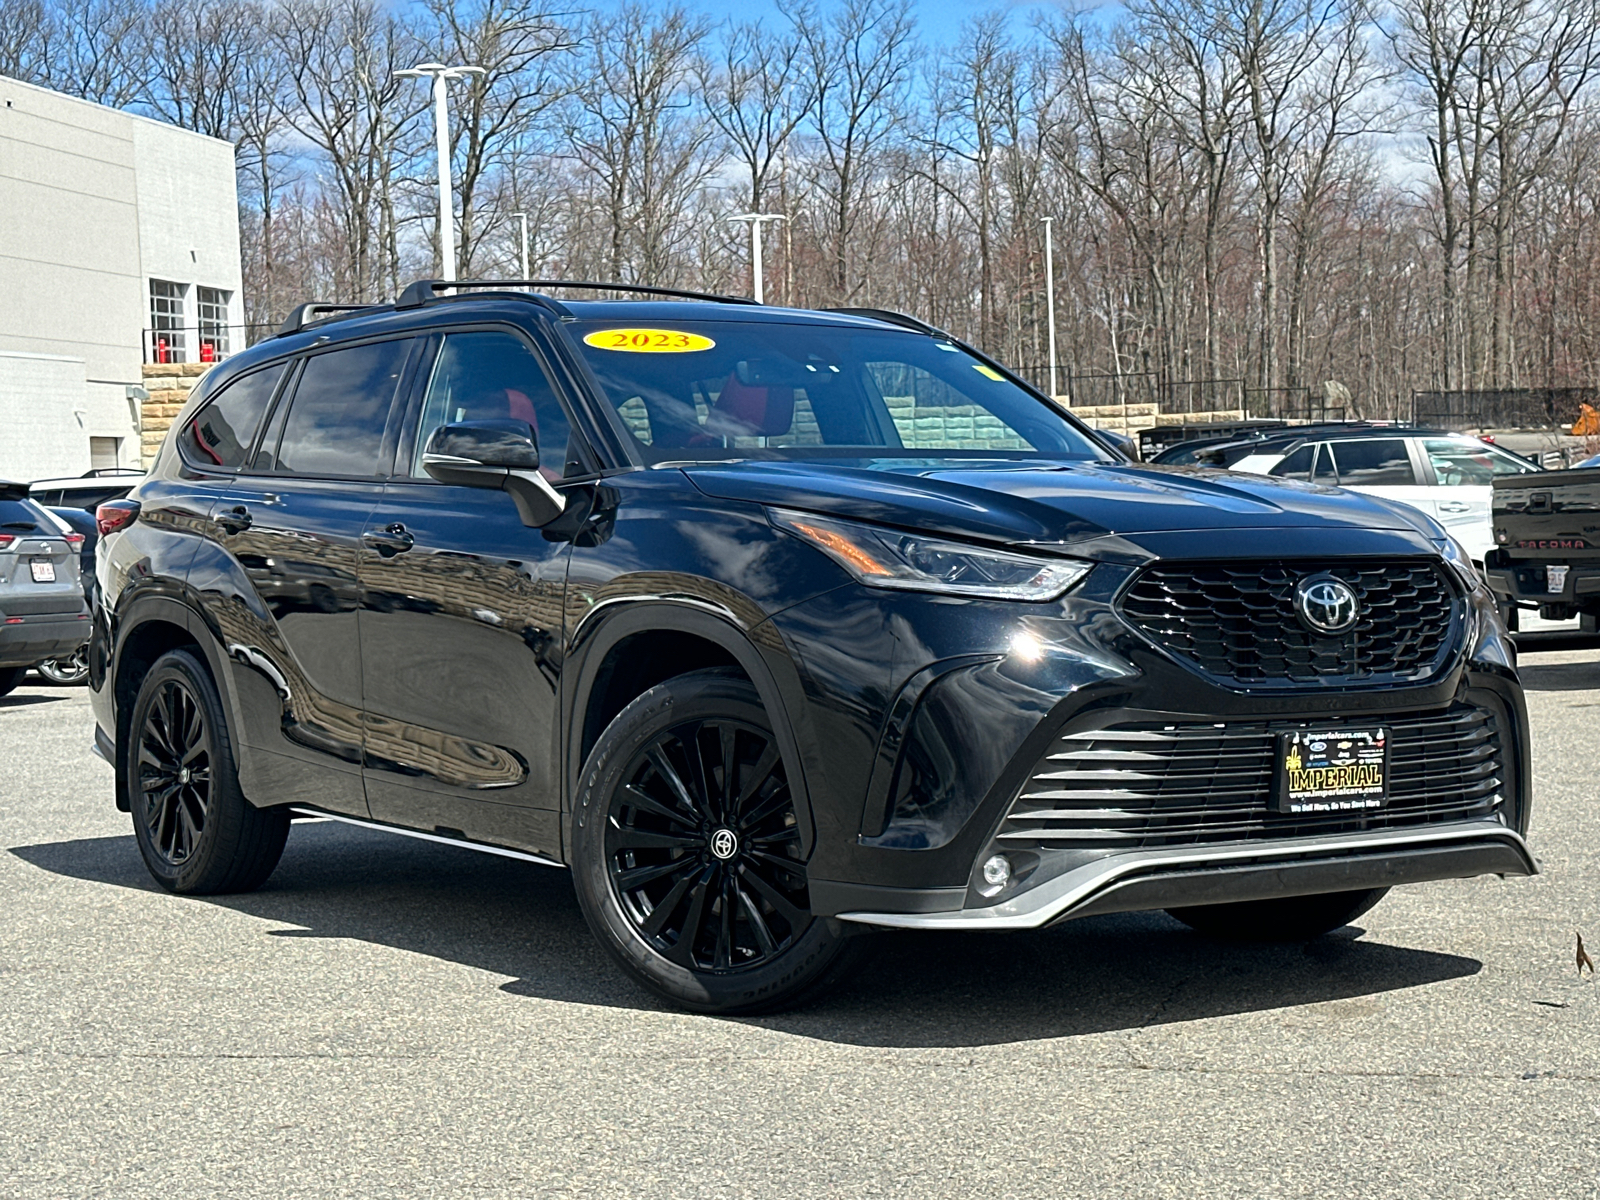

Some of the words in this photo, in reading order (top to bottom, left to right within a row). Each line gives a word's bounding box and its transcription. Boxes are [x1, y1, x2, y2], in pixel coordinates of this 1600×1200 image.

[612, 333, 690, 347] 2023
[1520, 540, 1584, 548] TACOMA
[1289, 765, 1383, 791] IMPERIAL
